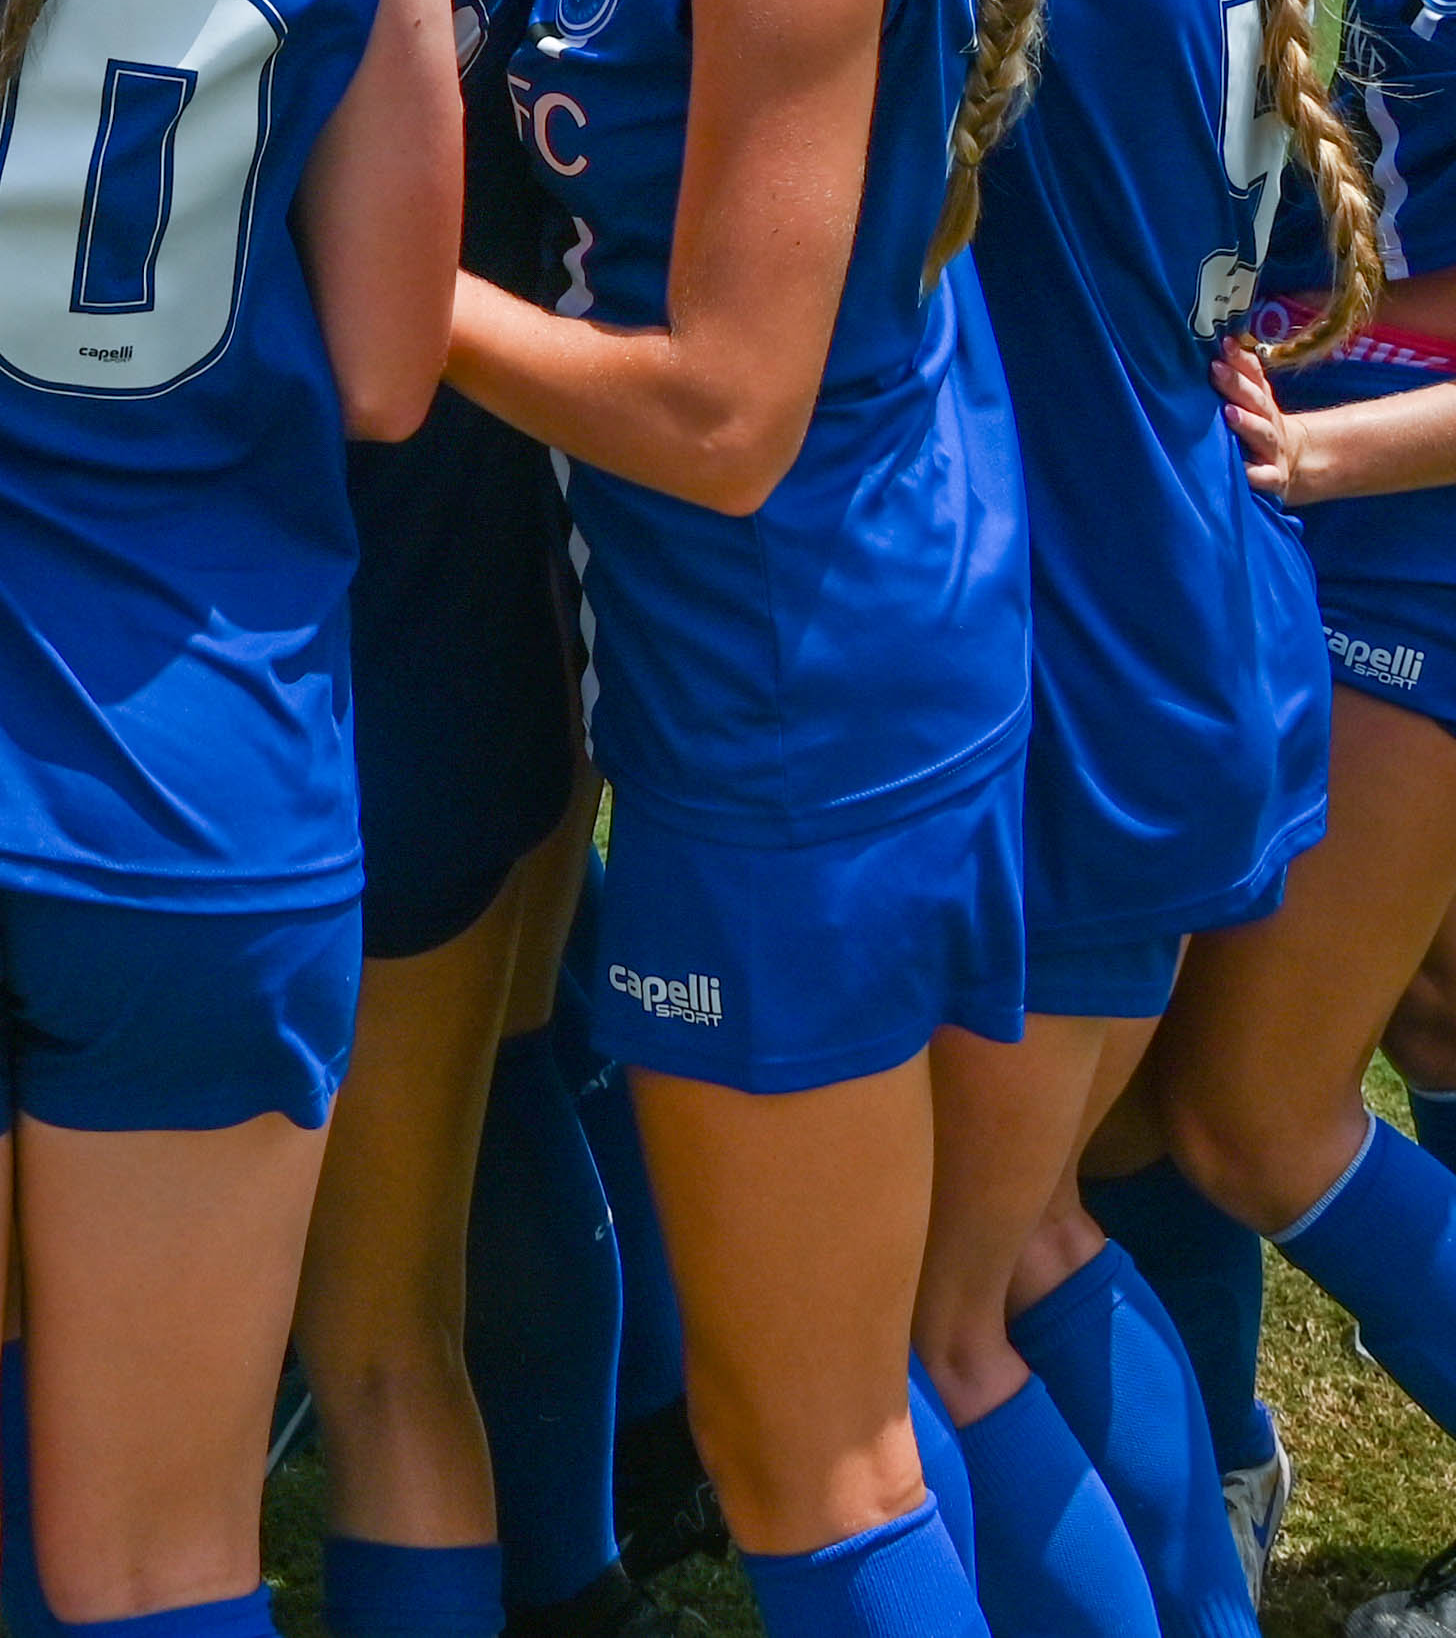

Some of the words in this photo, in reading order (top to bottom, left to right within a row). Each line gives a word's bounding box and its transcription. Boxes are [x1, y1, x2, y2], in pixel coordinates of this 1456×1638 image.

[79, 345, 134, 361] capelli
[1352, 662, 1418, 691] SPORT
[608, 964, 723, 1015] capelli
[655, 1003, 723, 1028] SPORT
